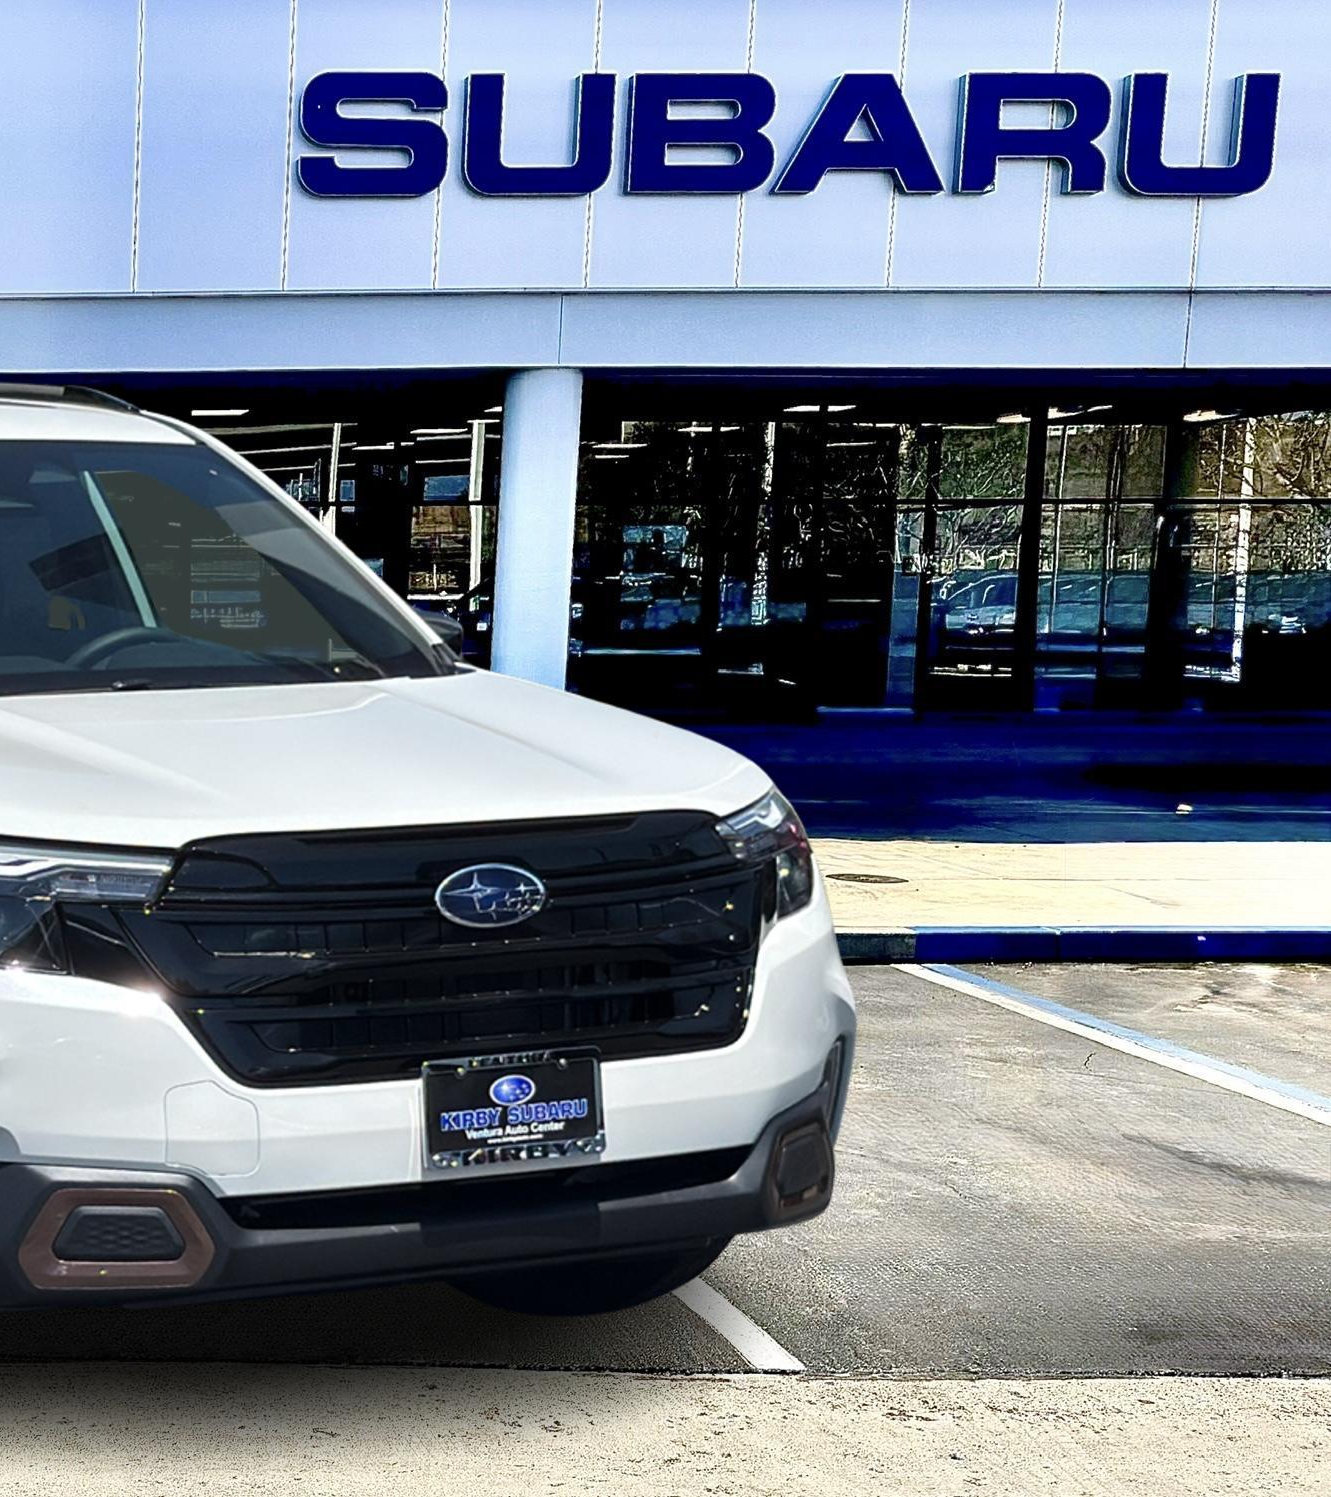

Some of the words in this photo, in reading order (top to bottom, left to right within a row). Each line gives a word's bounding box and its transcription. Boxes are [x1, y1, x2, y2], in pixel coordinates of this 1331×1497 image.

[297, 70, 1281, 199] SUBARU
[441, 1108, 502, 1131] KIRBY
[507, 1099, 588, 1124] SUBARU
[465, 1127, 503, 1140] Ventura
[504, 1122, 528, 1135] Auto
[530, 1120, 565, 1133] Center
[462, 1141, 572, 1166] KIRBY
